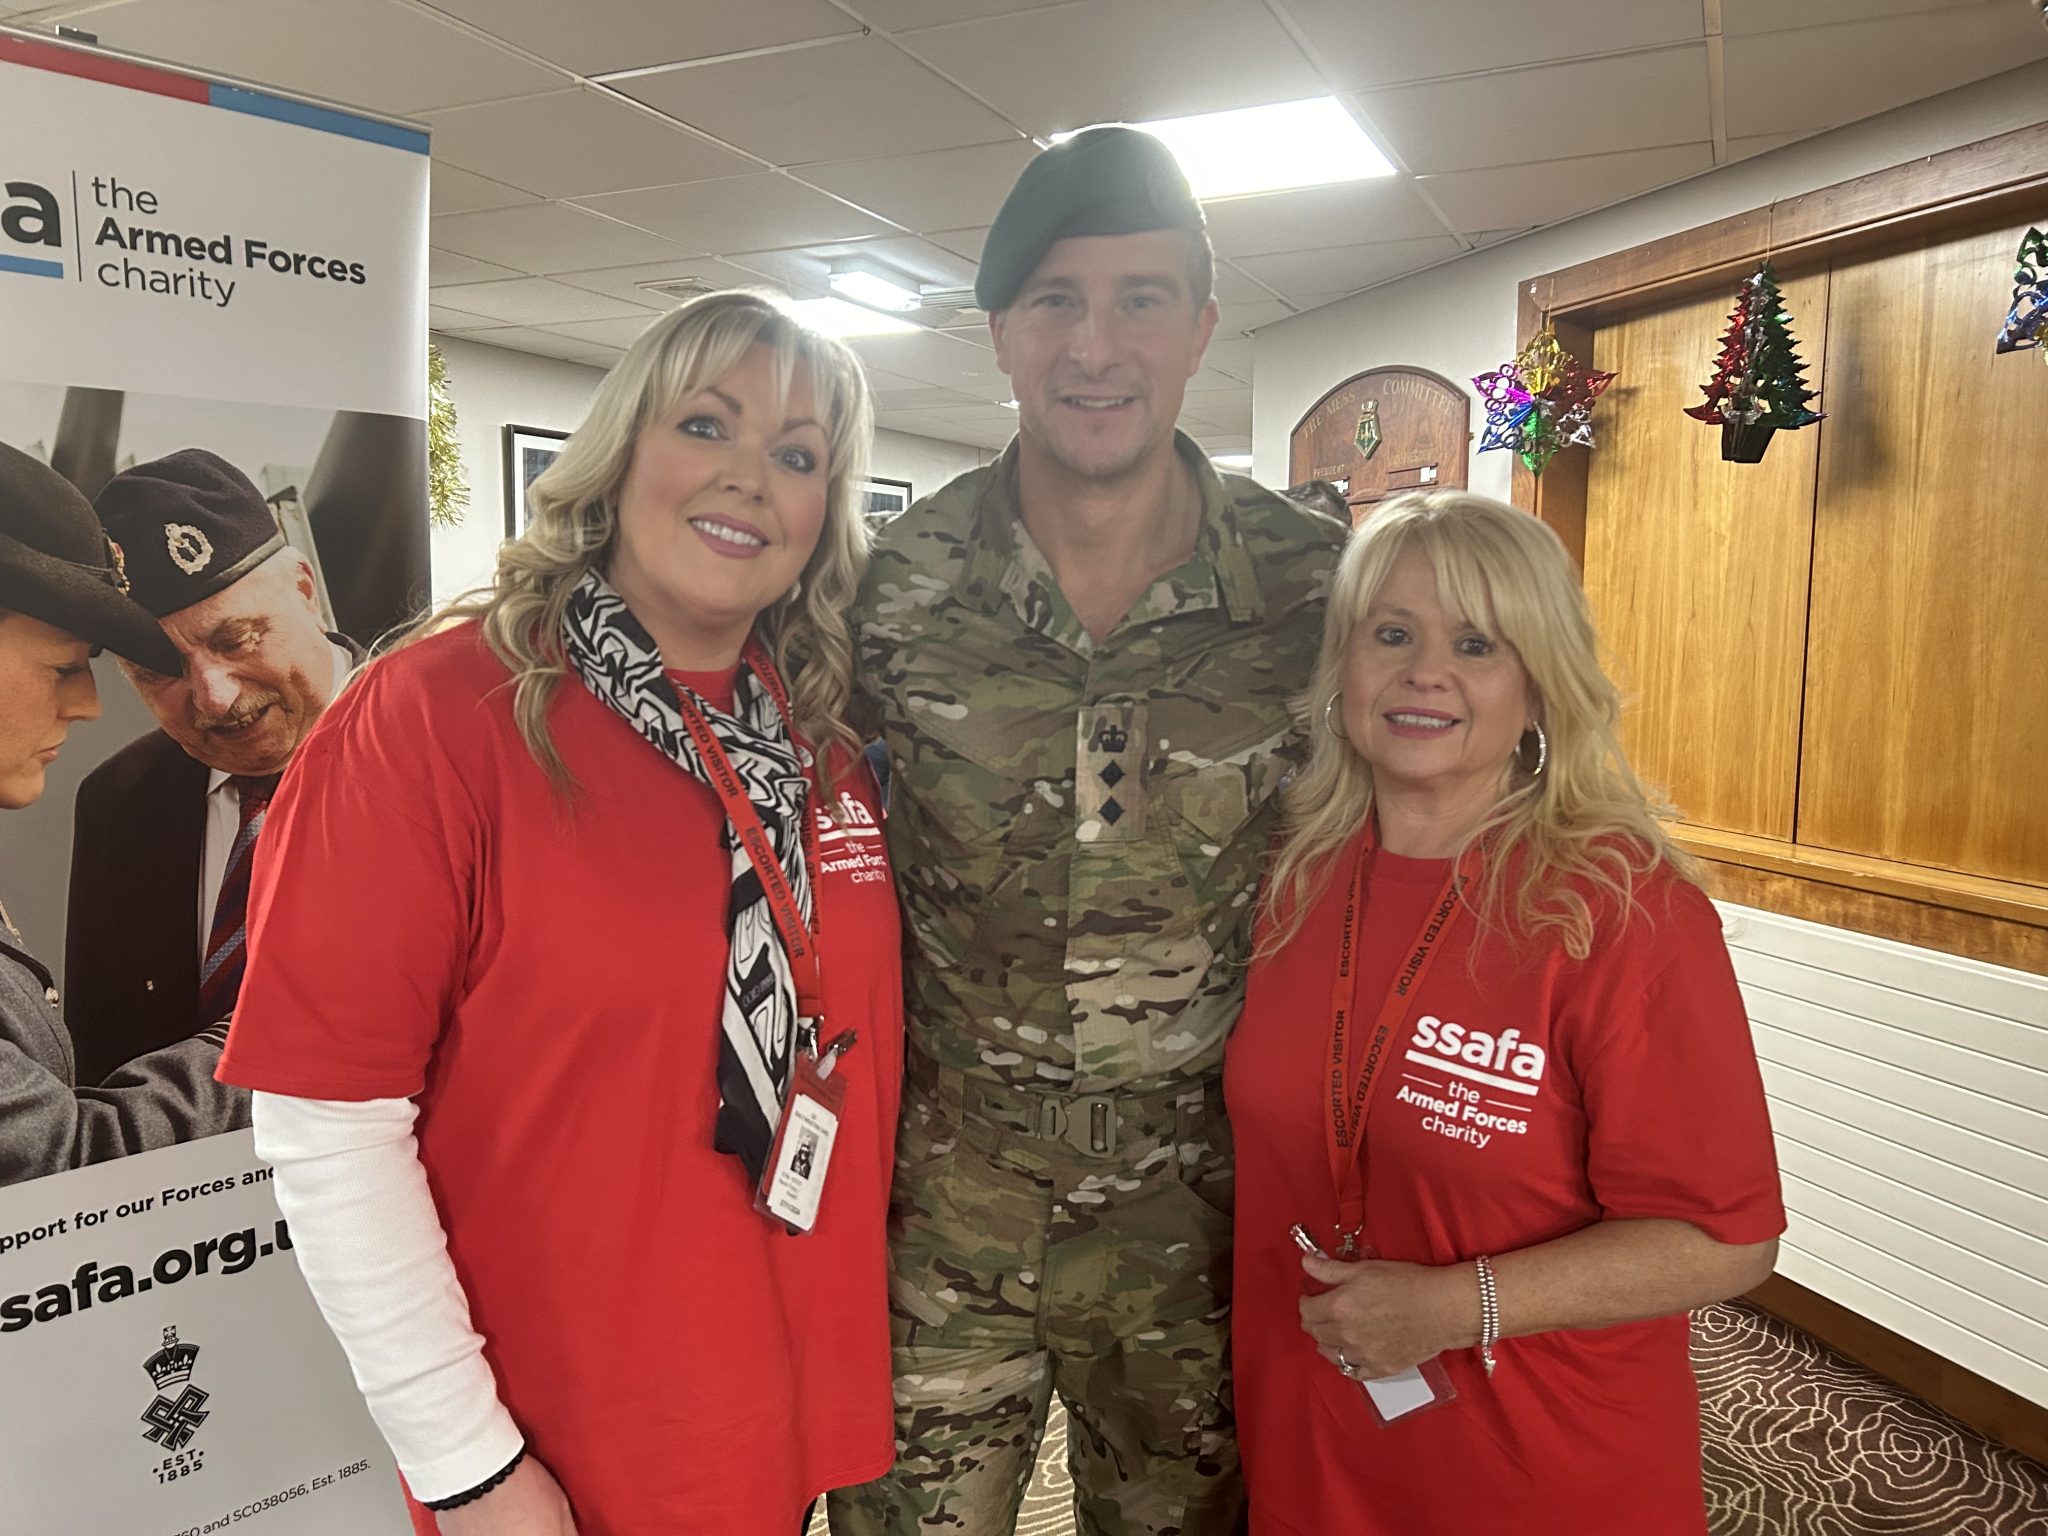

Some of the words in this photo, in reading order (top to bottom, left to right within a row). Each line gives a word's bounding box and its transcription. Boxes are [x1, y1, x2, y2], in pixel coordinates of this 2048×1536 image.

[92, 176, 158, 214] the
[95, 217, 233, 265] Armed
[244, 238, 366, 285] Forces
[98, 258, 235, 308] charity
[1303, 412, 1324, 439] THE
[1326, 390, 1355, 417] MESS
[1383, 379, 1456, 415] COMMITTEE
[1313, 464, 1345, 478] PRESIDENT
[706, 746, 739, 798] VISITOR
[821, 855, 865, 874] Armed
[845, 840, 866, 854] the
[746, 827, 786, 901] ESCORTED
[780, 904, 805, 958] VISITOR
[1340, 904, 1354, 977] ESCORTED
[1396, 946, 1430, 996] VISITOR
[1333, 1010, 1345, 1065] VISITOR
[1357, 1024, 1389, 1102] ESCORTED
[1411, 1015, 1546, 1081] ssafa
[1332, 1069, 1348, 1148] ESCORTED
[1396, 1085, 1460, 1118] Armed
[1461, 1104, 1529, 1135] Forces
[1448, 1081, 1480, 1103] the
[1421, 1115, 1491, 1149] charity
[0, 1218, 67, 1254] pport
[74, 1209, 108, 1230] for
[115, 1198, 154, 1220] our
[161, 1175, 236, 1208] Forces
[157, 1459, 203, 1485] 1885
[203, 1513, 230, 1535] and
[233, 1484, 310, 1522] SC038056,
[312, 1474, 336, 1491] Est.
[338, 1459, 371, 1480] 1885.
